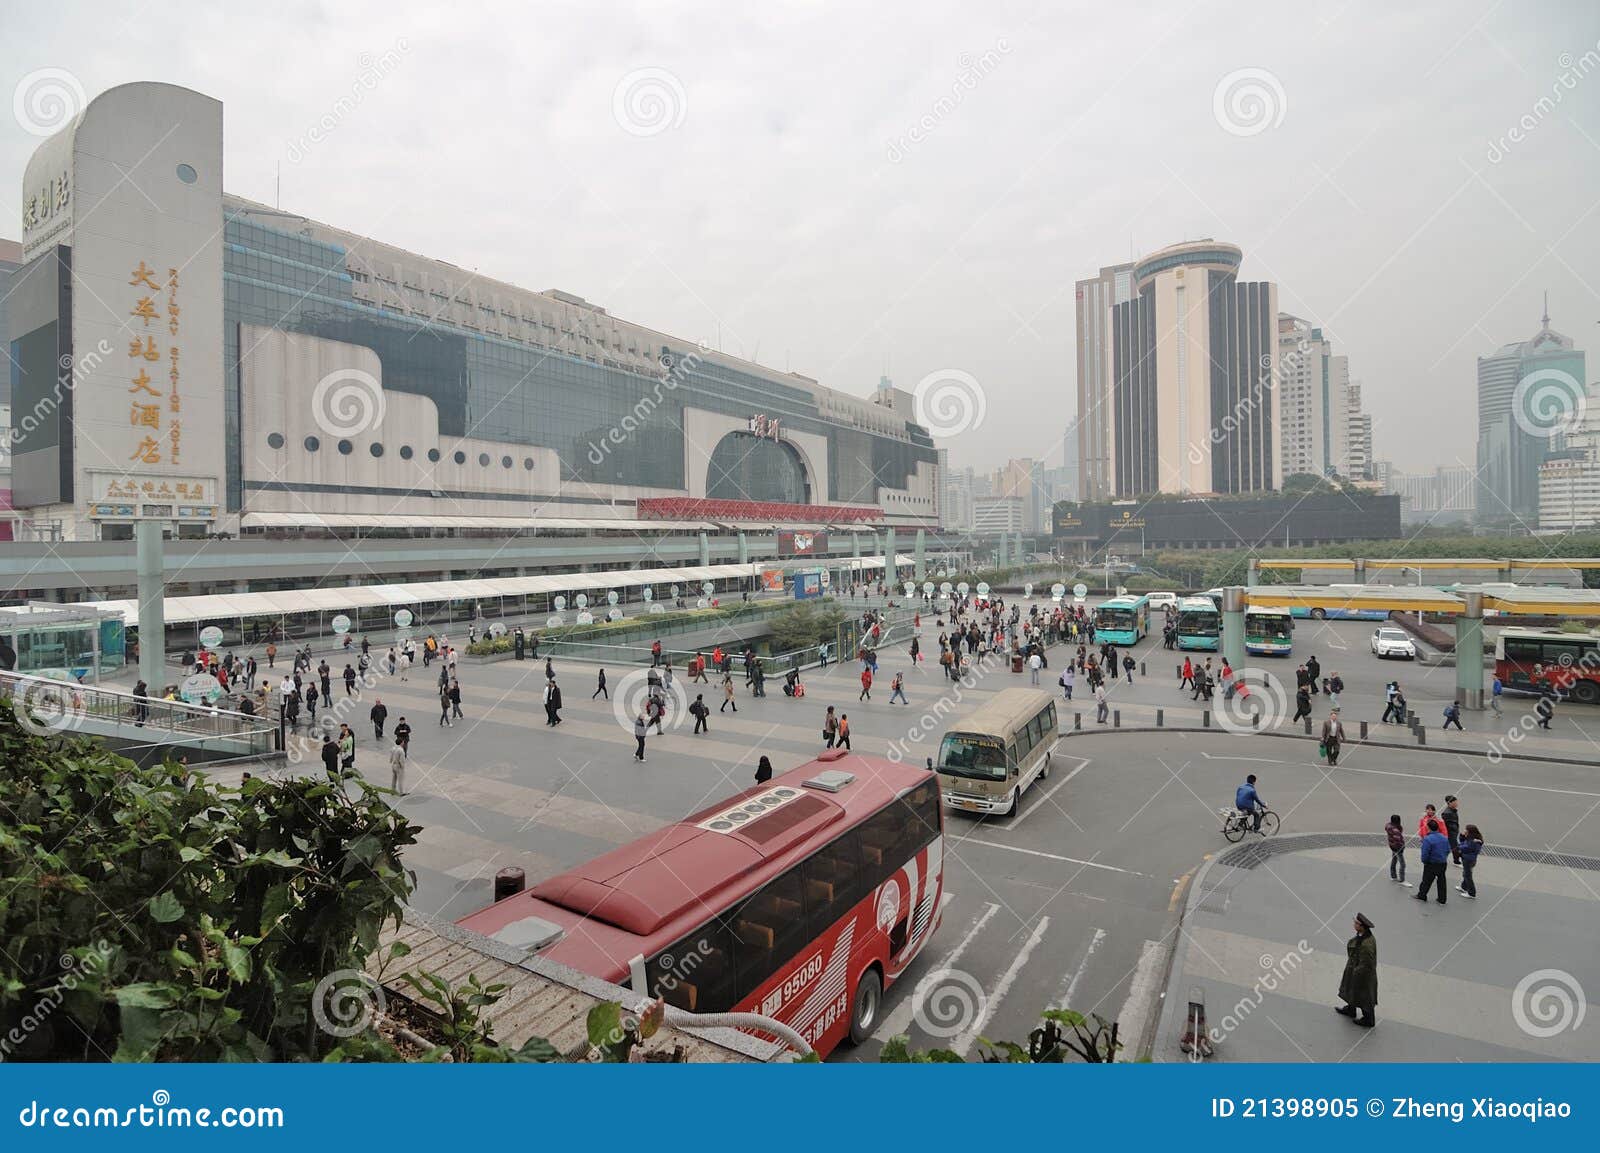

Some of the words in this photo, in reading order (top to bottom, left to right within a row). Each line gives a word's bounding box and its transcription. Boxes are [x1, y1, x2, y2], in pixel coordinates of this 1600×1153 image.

[167, 268, 180, 336] RAILWAY
[168, 346, 180, 413] STATION
[168, 420, 180, 465] HOTEL
[784, 955, 822, 1002] 95080
